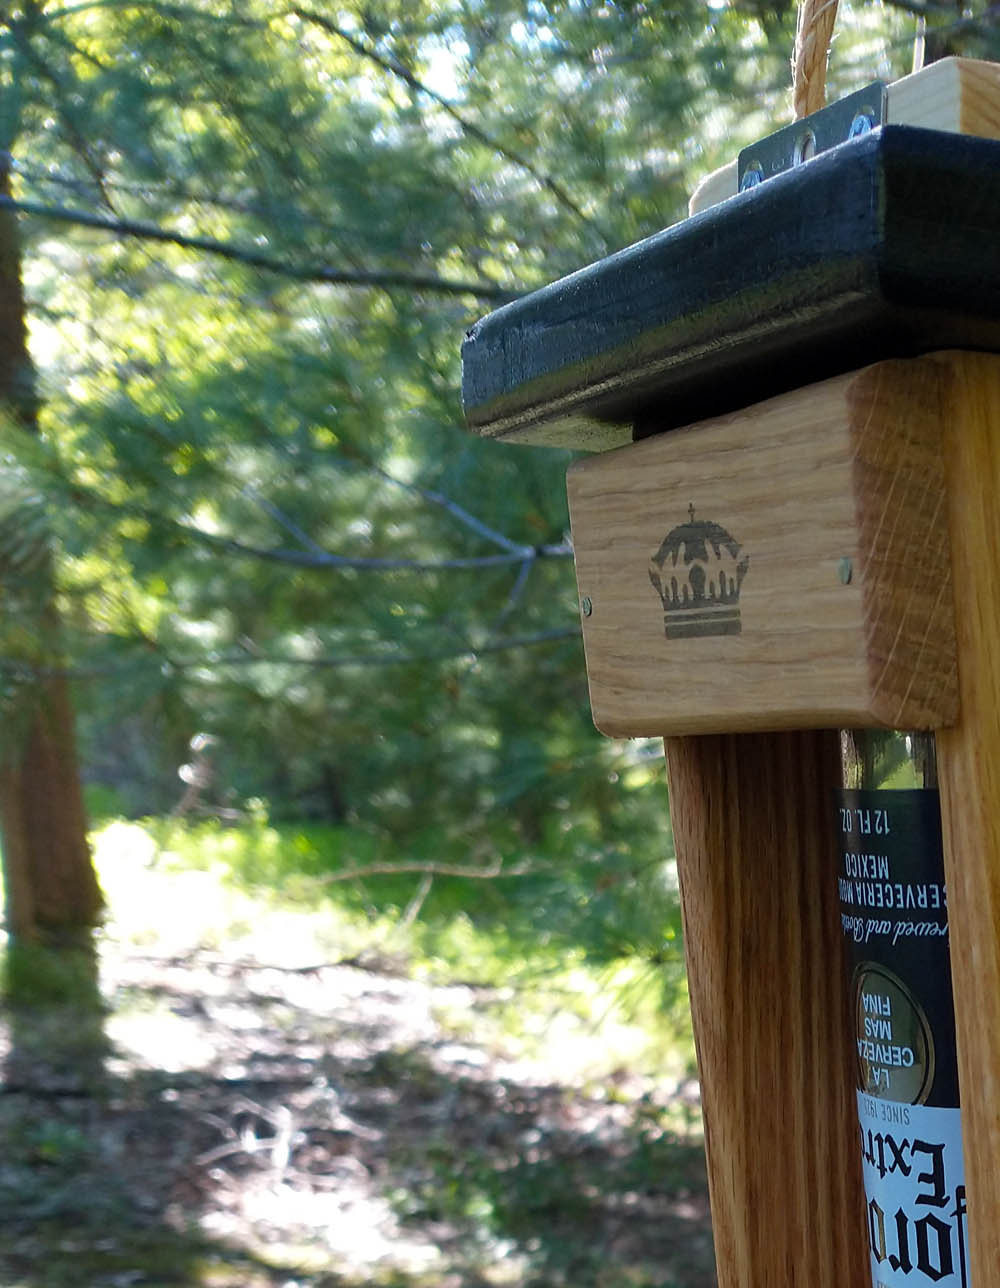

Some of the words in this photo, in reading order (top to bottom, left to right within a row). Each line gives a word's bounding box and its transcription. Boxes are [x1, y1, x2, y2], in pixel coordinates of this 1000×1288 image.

[854, 809, 872, 834] FL.
[874, 810, 891, 835] 12
[845, 852, 889, 880] MEXICO
[865, 916, 893, 944] and
[893, 919, 949, 946] rewed
[861, 992, 892, 1017] FINA
[865, 1018, 892, 1040] MAS
[857, 1039, 915, 1068] CERVEZA
[872, 1065, 890, 1089] LA
[881, 1103, 911, 1126] SINCE
